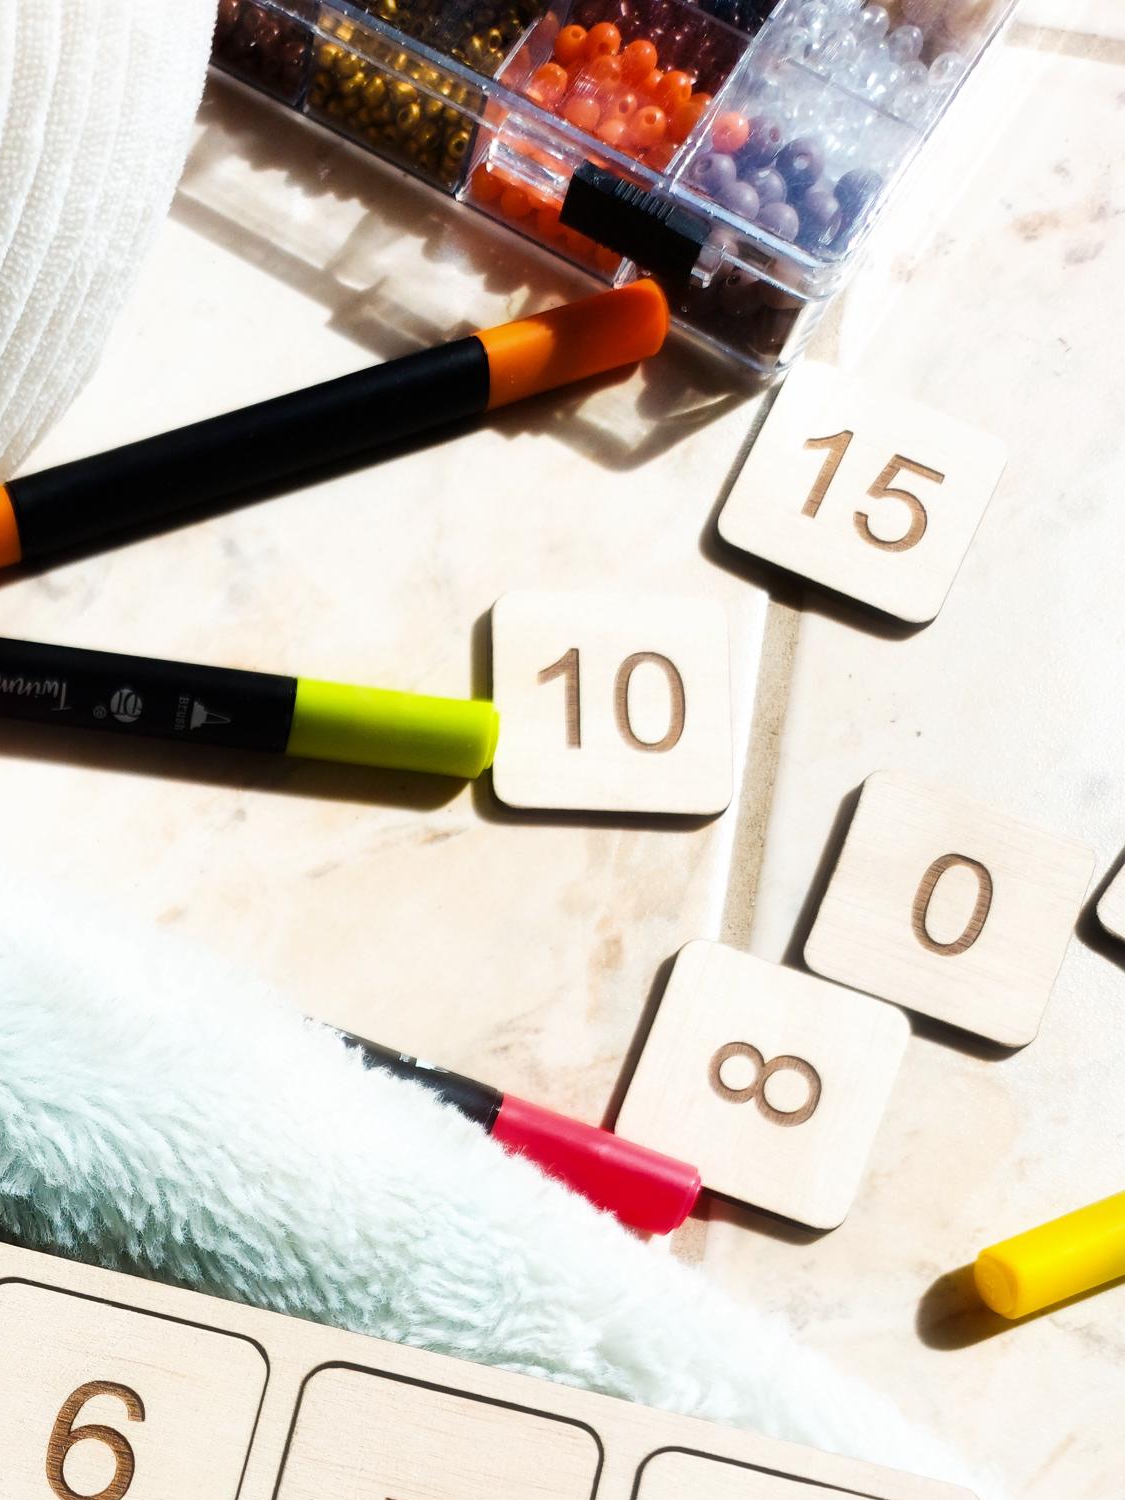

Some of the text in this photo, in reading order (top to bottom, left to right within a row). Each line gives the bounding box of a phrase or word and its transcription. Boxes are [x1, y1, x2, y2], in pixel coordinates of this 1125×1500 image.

[801, 429, 946, 553] 15
[537, 646, 687, 754] 10
[911, 852, 994, 957] 0
[708, 1041, 823, 1128] 8
